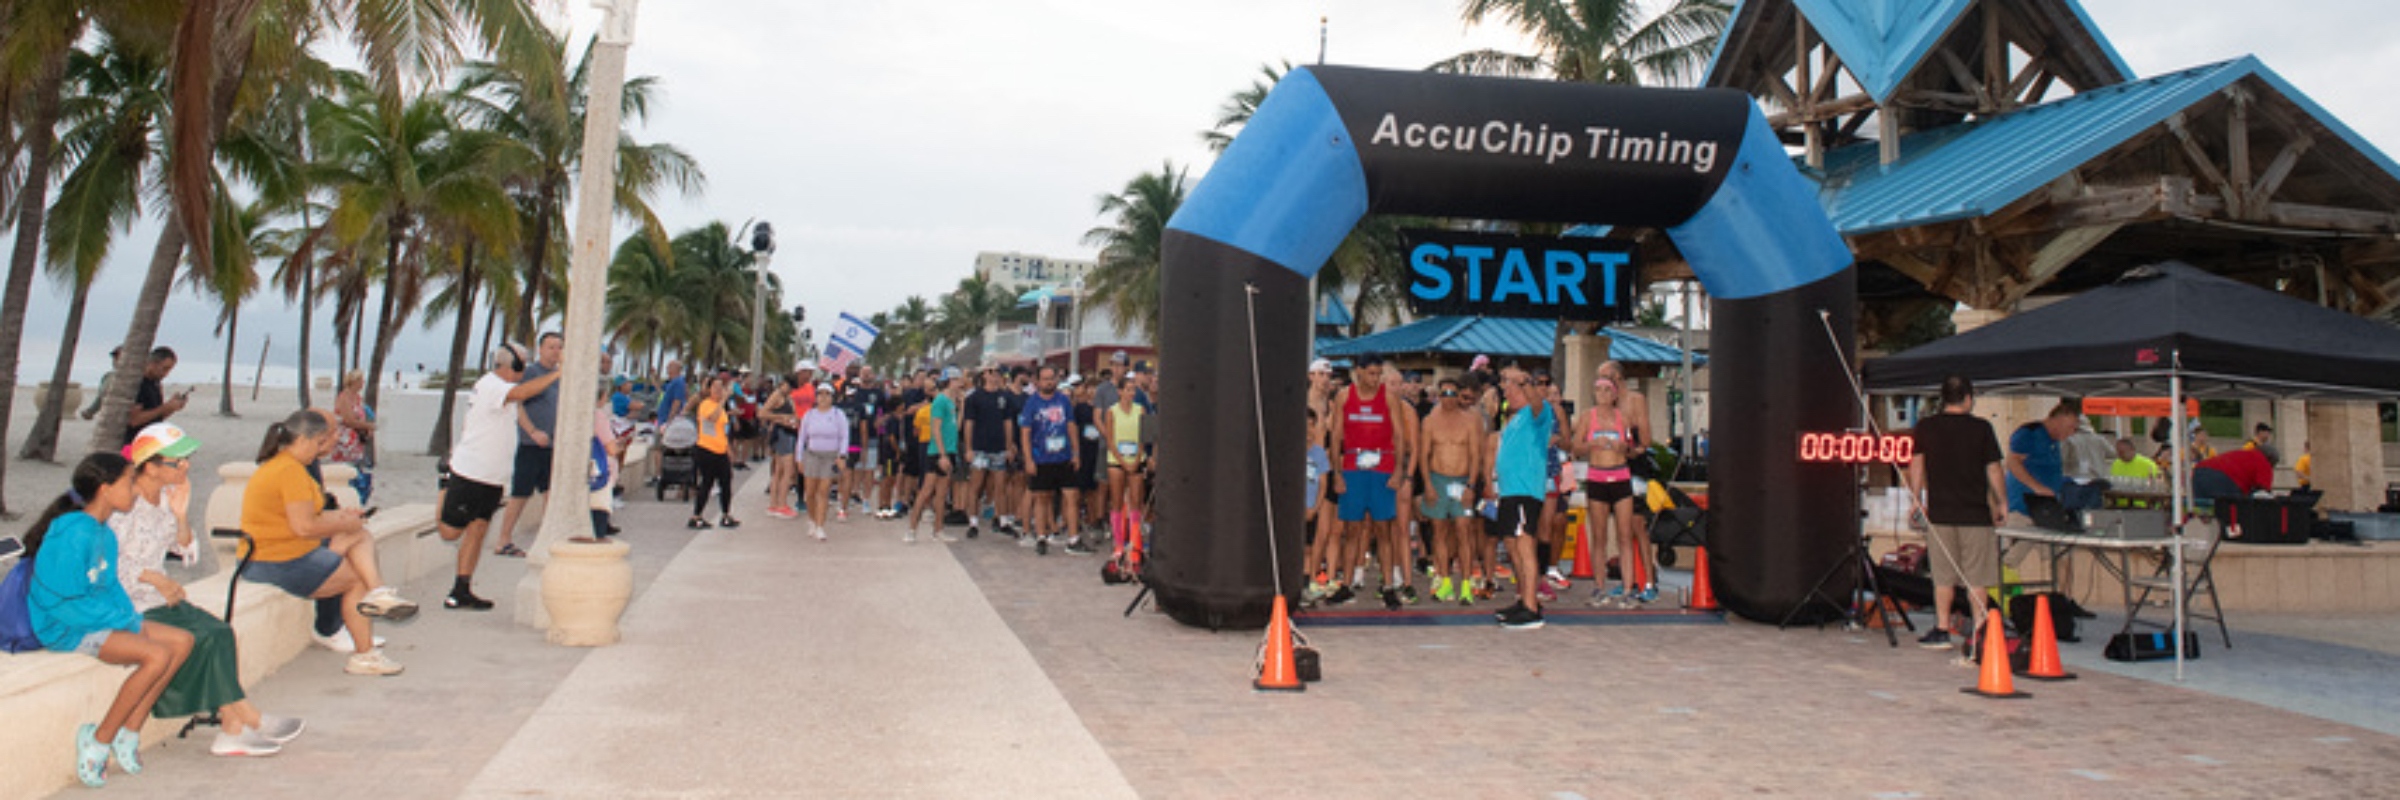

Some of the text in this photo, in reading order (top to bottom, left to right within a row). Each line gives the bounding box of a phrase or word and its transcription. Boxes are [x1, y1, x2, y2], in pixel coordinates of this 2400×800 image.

[1371, 112, 1718, 172] AccuChip Timing
[1410, 242, 1630, 306] START
